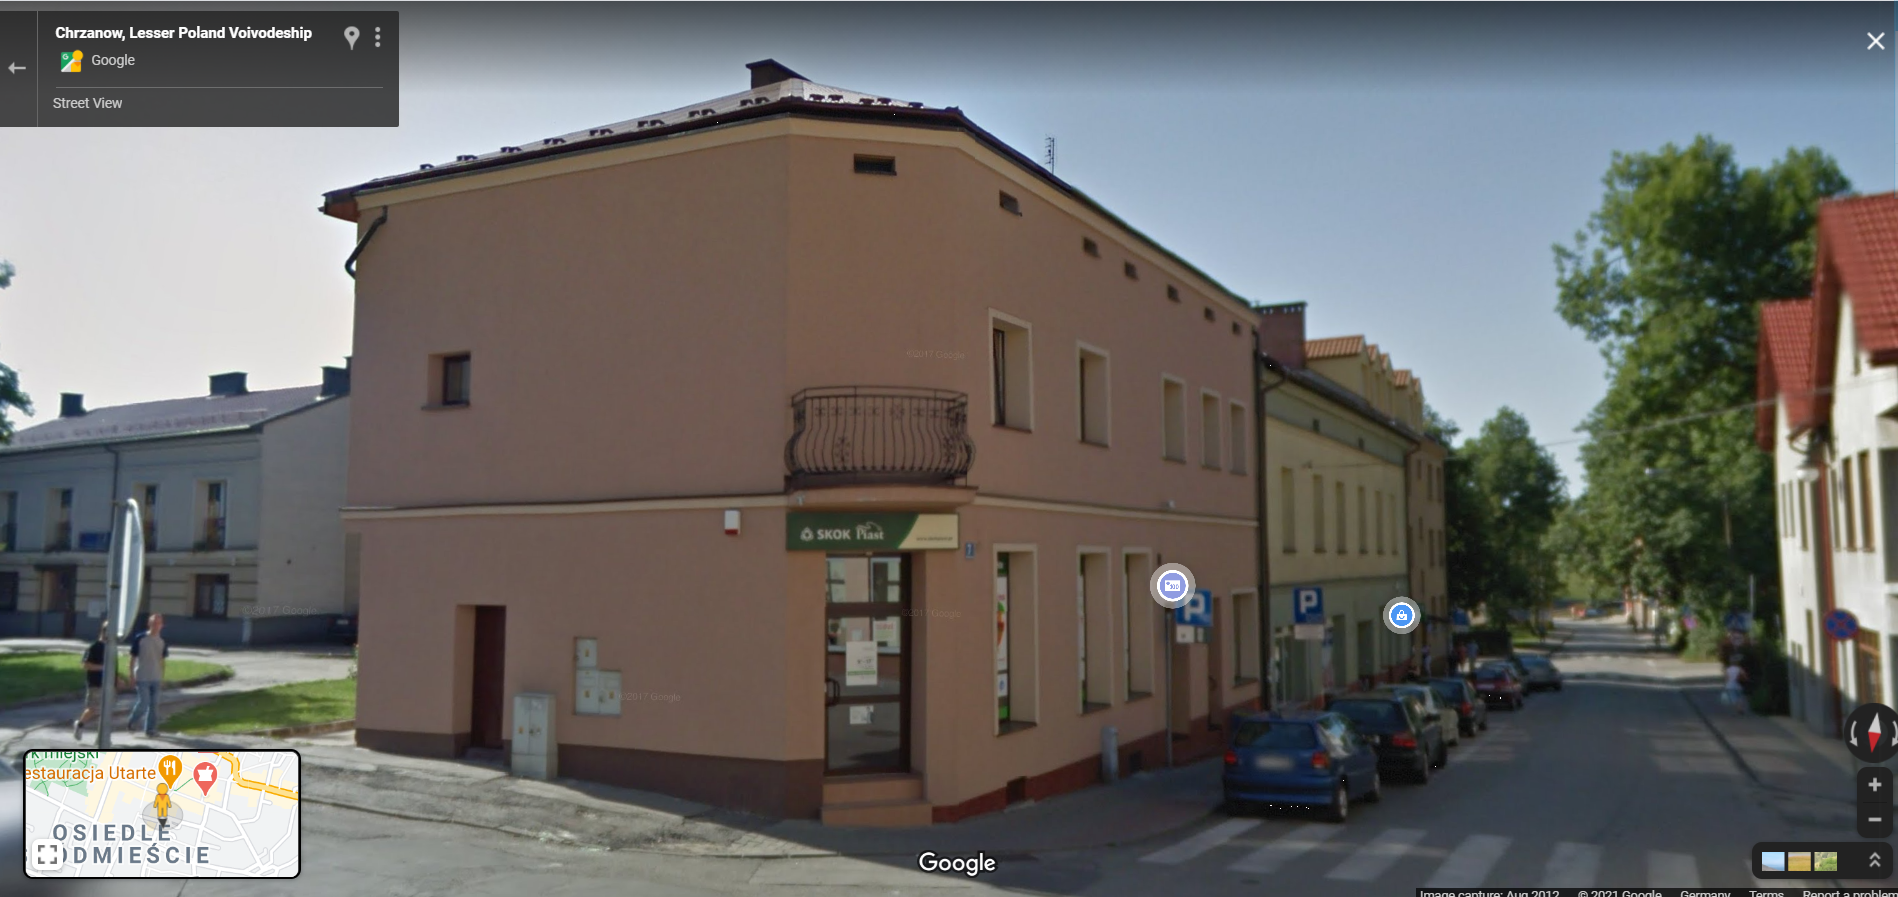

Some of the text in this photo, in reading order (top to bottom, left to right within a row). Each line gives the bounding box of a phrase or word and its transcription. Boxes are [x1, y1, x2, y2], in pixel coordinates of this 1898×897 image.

[817, 528, 884, 540] SKOK Piast
[1300, 590, 1318, 614] P
